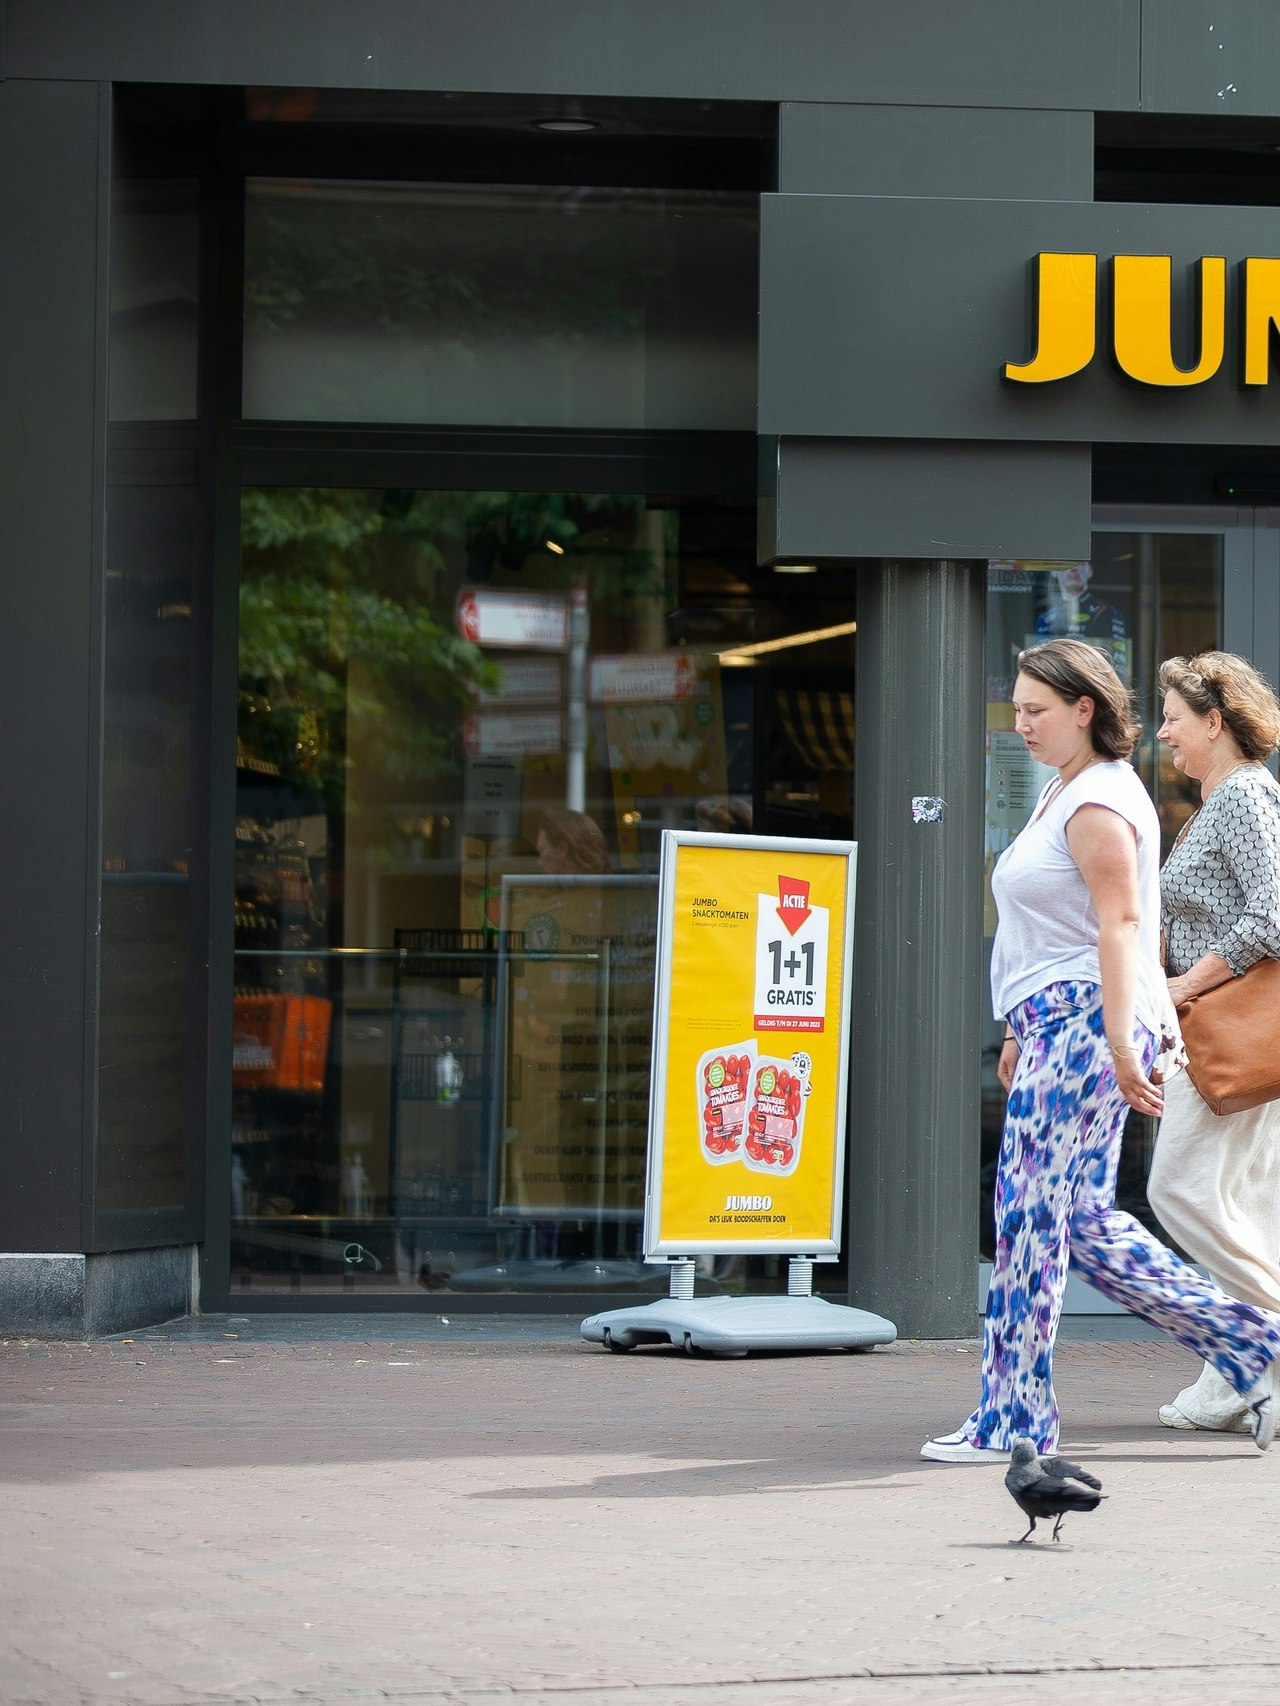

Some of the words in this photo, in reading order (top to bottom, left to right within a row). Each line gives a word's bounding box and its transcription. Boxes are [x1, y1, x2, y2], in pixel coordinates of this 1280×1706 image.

[692, 898, 718, 907] JUMBO
[783, 894, 806, 909] ACTIE
[692, 909, 749, 919] SNACKTOMATEN
[768, 940, 815, 986] 1+1
[758, 1019, 775, 1027] GELDIG
[798, 1020, 809, 1028] JUNI
[724, 1195, 773, 1211] JUMBO
[721, 1215, 733, 1223] LEUK
[734, 1215, 772, 1223] BOODSCHAPPEN
[773, 1215, 787, 1223] DOEN
